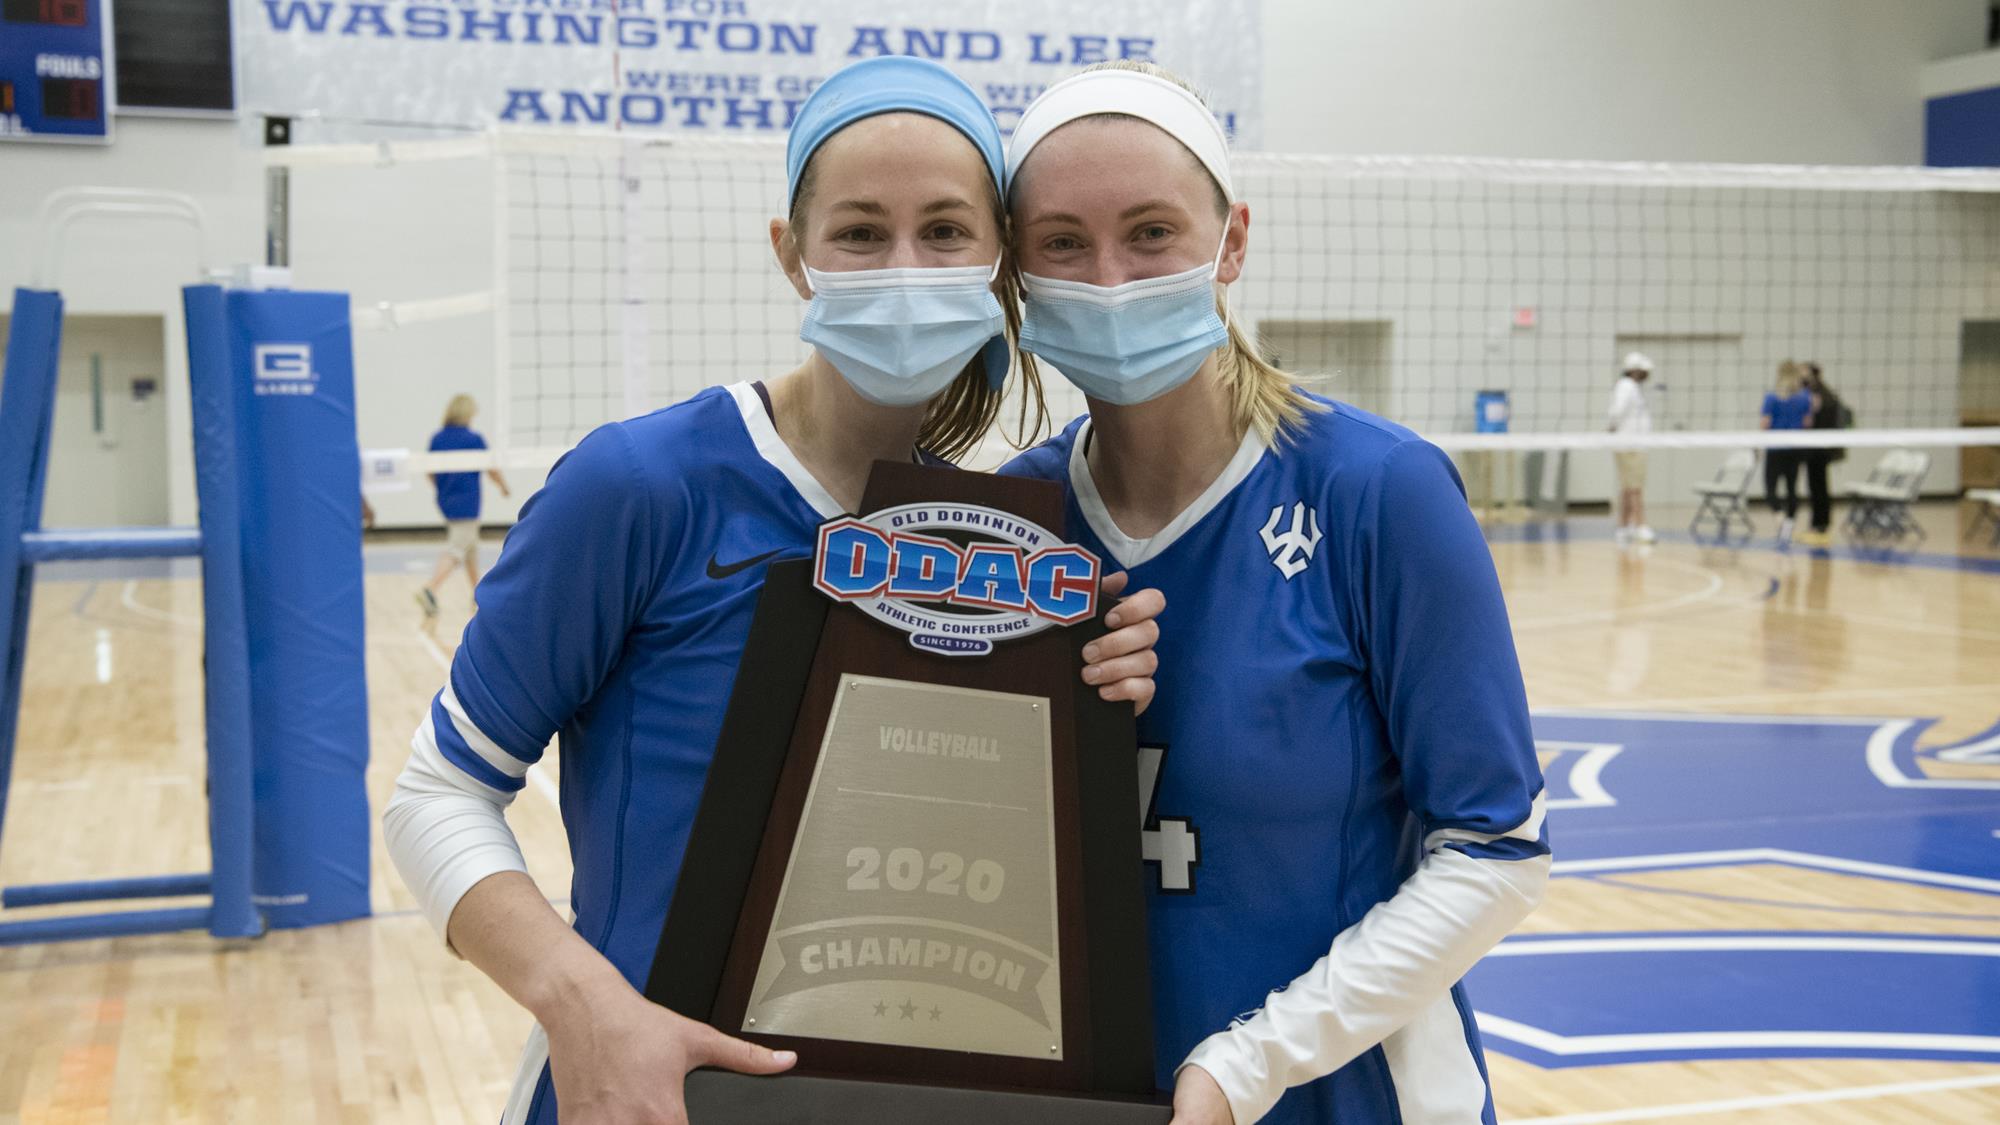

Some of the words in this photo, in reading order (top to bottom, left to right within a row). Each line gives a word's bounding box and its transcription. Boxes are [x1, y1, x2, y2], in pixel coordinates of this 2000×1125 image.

[262, 0, 817, 54] WASHINGTON
[847, 27, 1002, 61] AND
[1028, 34, 1157, 64] LEE
[35, 53, 101, 80] FOULS
[499, 89, 806, 129] ANOTH
[892, 511, 928, 527] OLD
[938, 510, 1041, 545] DOMINION
[819, 521, 1097, 621] ODAC
[877, 602, 937, 630] ATHLETIC
[942, 617, 1031, 635] CONFERENCE
[920, 636, 952, 647] SINCE
[955, 641, 980, 650] 1976
[879, 725, 1001, 762] VOLLEYBALL
[846, 846, 1006, 904] 2020
[800, 936, 1026, 993] CHAMPION
